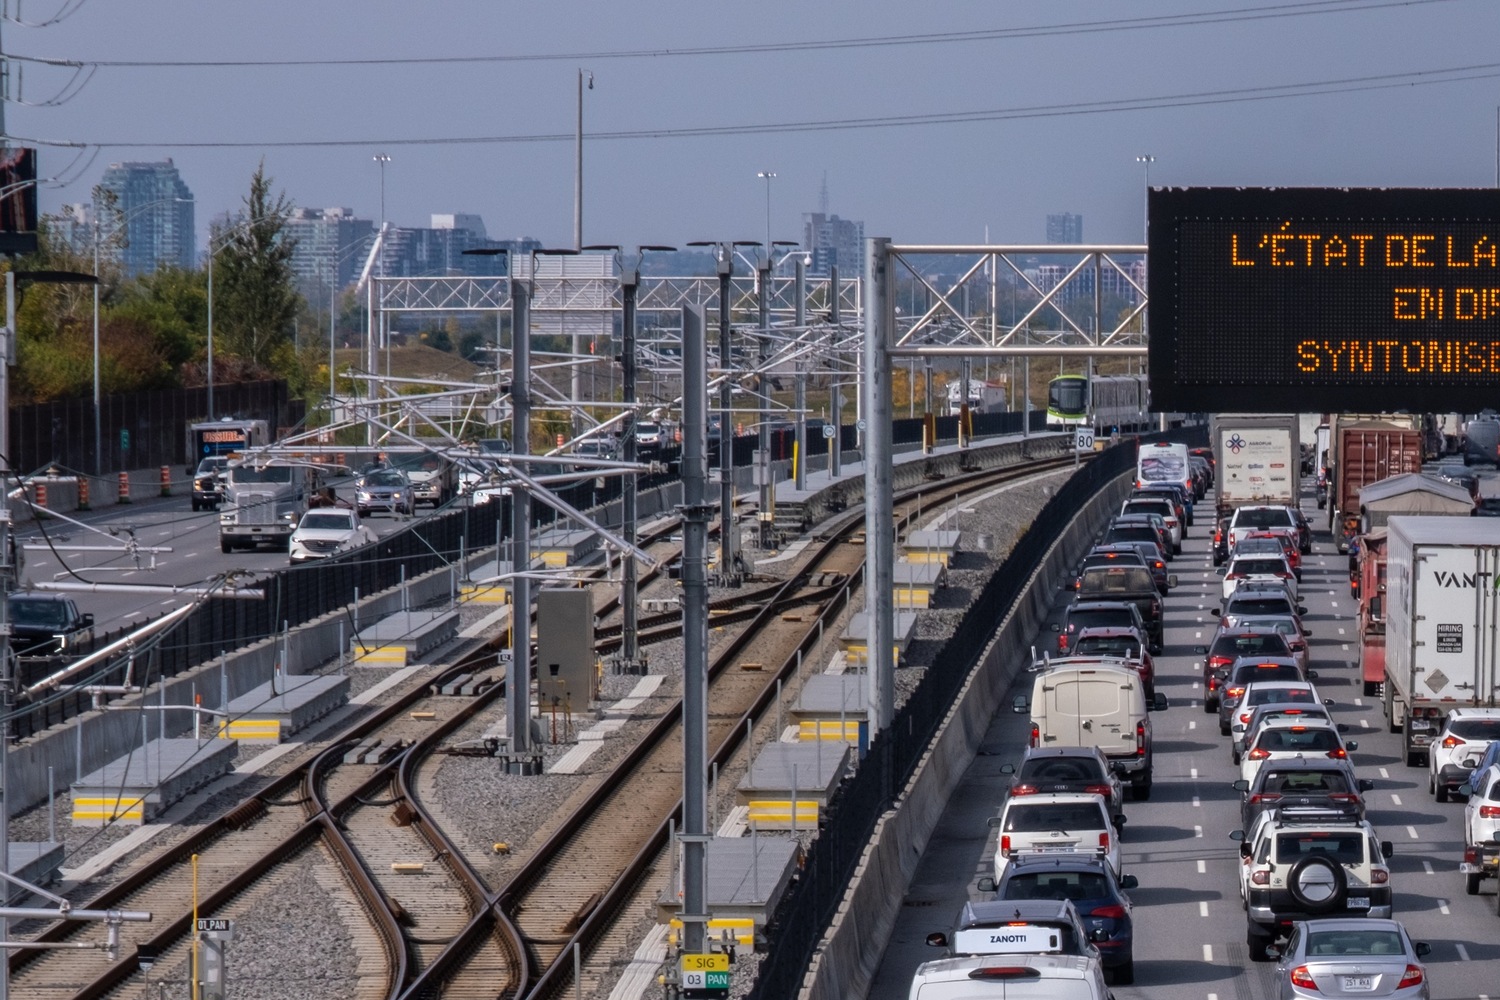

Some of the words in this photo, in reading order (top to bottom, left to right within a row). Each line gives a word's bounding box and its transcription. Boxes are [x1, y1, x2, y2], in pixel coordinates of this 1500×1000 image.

[1231, 222, 1373, 267] L'ÉTAT
[1386, 235, 1434, 267] DE
[1447, 235, 1496, 267] LA
[1394, 288, 1443, 320] EN
[1078, 435, 1093, 448] 80
[990, 935, 1027, 943] ZANOTTI
[696, 958, 715, 968] SIG
[687, 975, 702, 985] 03
[707, 974, 728, 985] PAN
